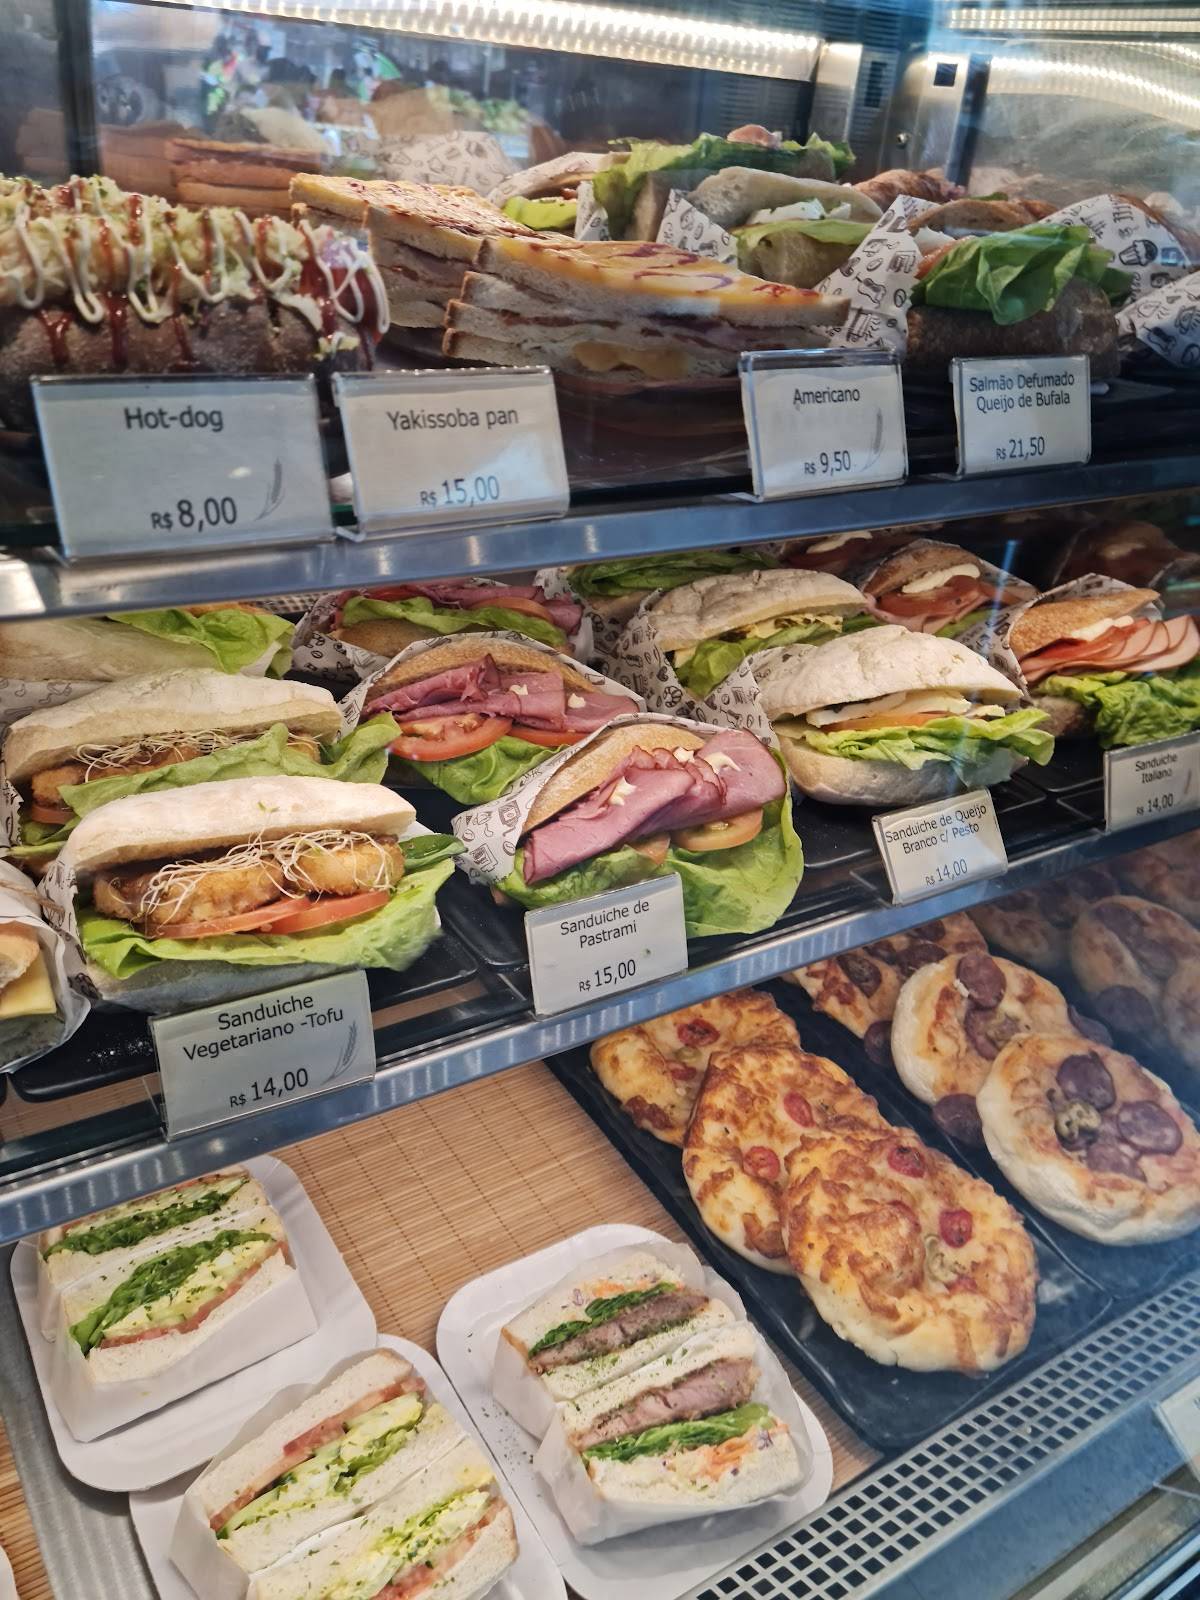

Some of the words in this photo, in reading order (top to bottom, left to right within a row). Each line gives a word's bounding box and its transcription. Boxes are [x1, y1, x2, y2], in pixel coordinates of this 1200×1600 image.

[969, 375, 1014, 392] Salmão
[1017, 371, 1075, 389] Defumado
[793, 387, 861, 405] Americano
[976, 395, 1015, 414] Queijo
[1018, 393, 1032, 408] de
[123, 405, 224, 432] Hot-dog
[386, 408, 480, 431] Yakissoba
[486, 409, 519, 430] pan
[1008, 436, 1045, 460] 21,50
[804, 462, 817, 476] R$
[819, 450, 851, 477] 9,50
[420, 490, 437, 508] R$
[441, 475, 500, 508] 15,00
[151, 511, 173, 532] R$
[176, 496, 237, 532] 8,00
[1135, 752, 1178, 772] Sanduiche
[1141, 768, 1173, 784] Italiano
[1147, 793, 1174, 813] 14,00
[885, 819, 938, 843] Sanduiche
[940, 814, 953, 827] de
[955, 803, 987, 821] Queijo
[902, 836, 938, 854] Branco
[940, 829, 949, 843] c/
[952, 822, 980, 839] Pesto
[936, 858, 968, 882] 14,00
[560, 907, 630, 936] Sanduiche
[633, 899, 650, 914] de
[579, 919, 637, 949] Pastrami
[579, 979, 591, 993] R$
[594, 959, 636, 987] 15,00
[217, 995, 314, 1031] Sanduiche
[183, 1021, 295, 1061] Vegetariano
[300, 1007, 344, 1029] -Tofu
[229, 1093, 247, 1109] R$
[251, 1067, 308, 1102] 14,00
